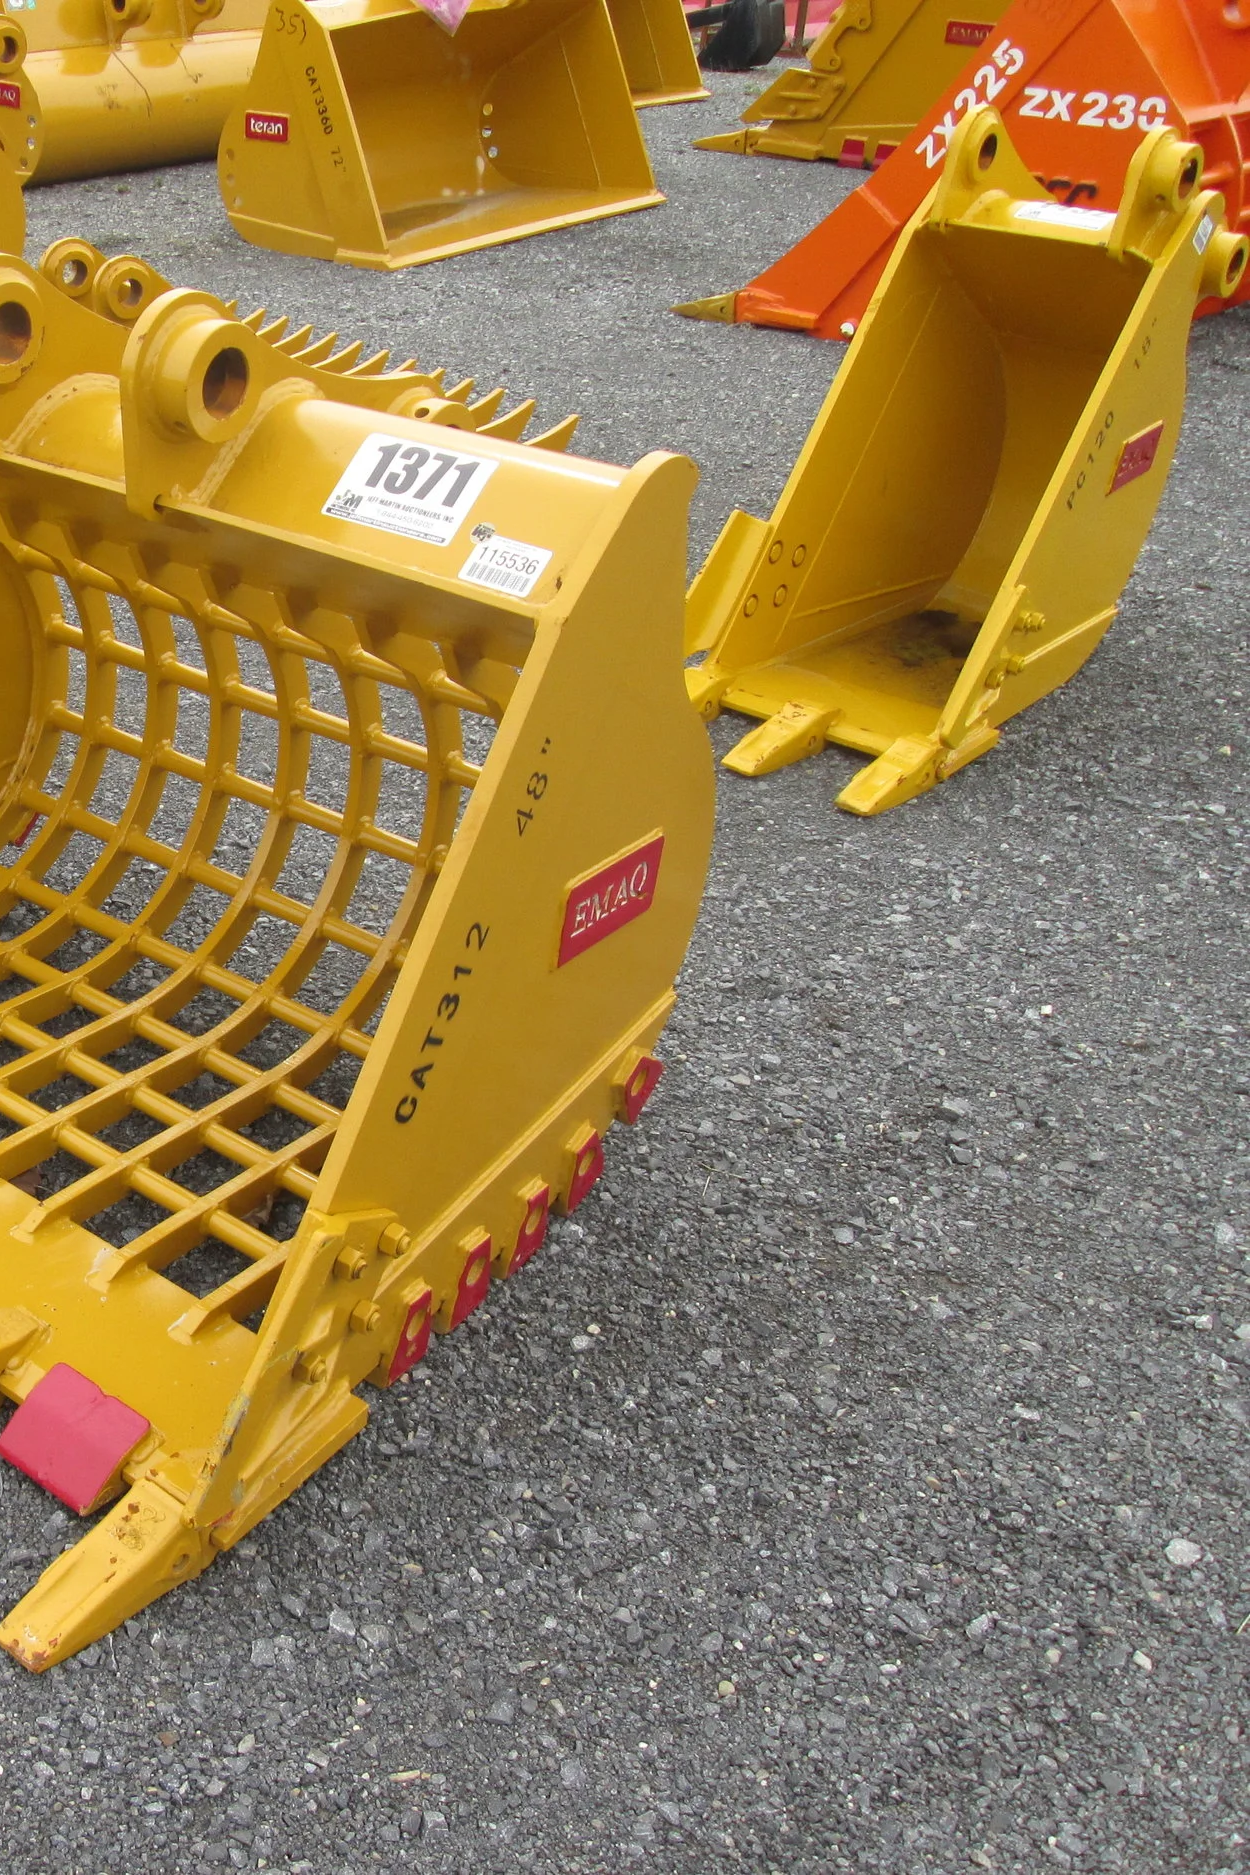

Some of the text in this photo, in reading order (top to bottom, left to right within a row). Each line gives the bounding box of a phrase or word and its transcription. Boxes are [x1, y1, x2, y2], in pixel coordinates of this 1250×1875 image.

[250, 117, 283, 136] teran
[305, 66, 334, 136] CAT336D
[915, 38, 1025, 169] ZX225
[1018, 86, 1167, 132] ZX230
[365, 443, 481, 508] 1371
[1066, 410, 1114, 510] PC120
[478, 545, 540, 576] 115536
[393, 737, 552, 1125] CAT312 48"
[570, 861, 650, 938] EMAQ
